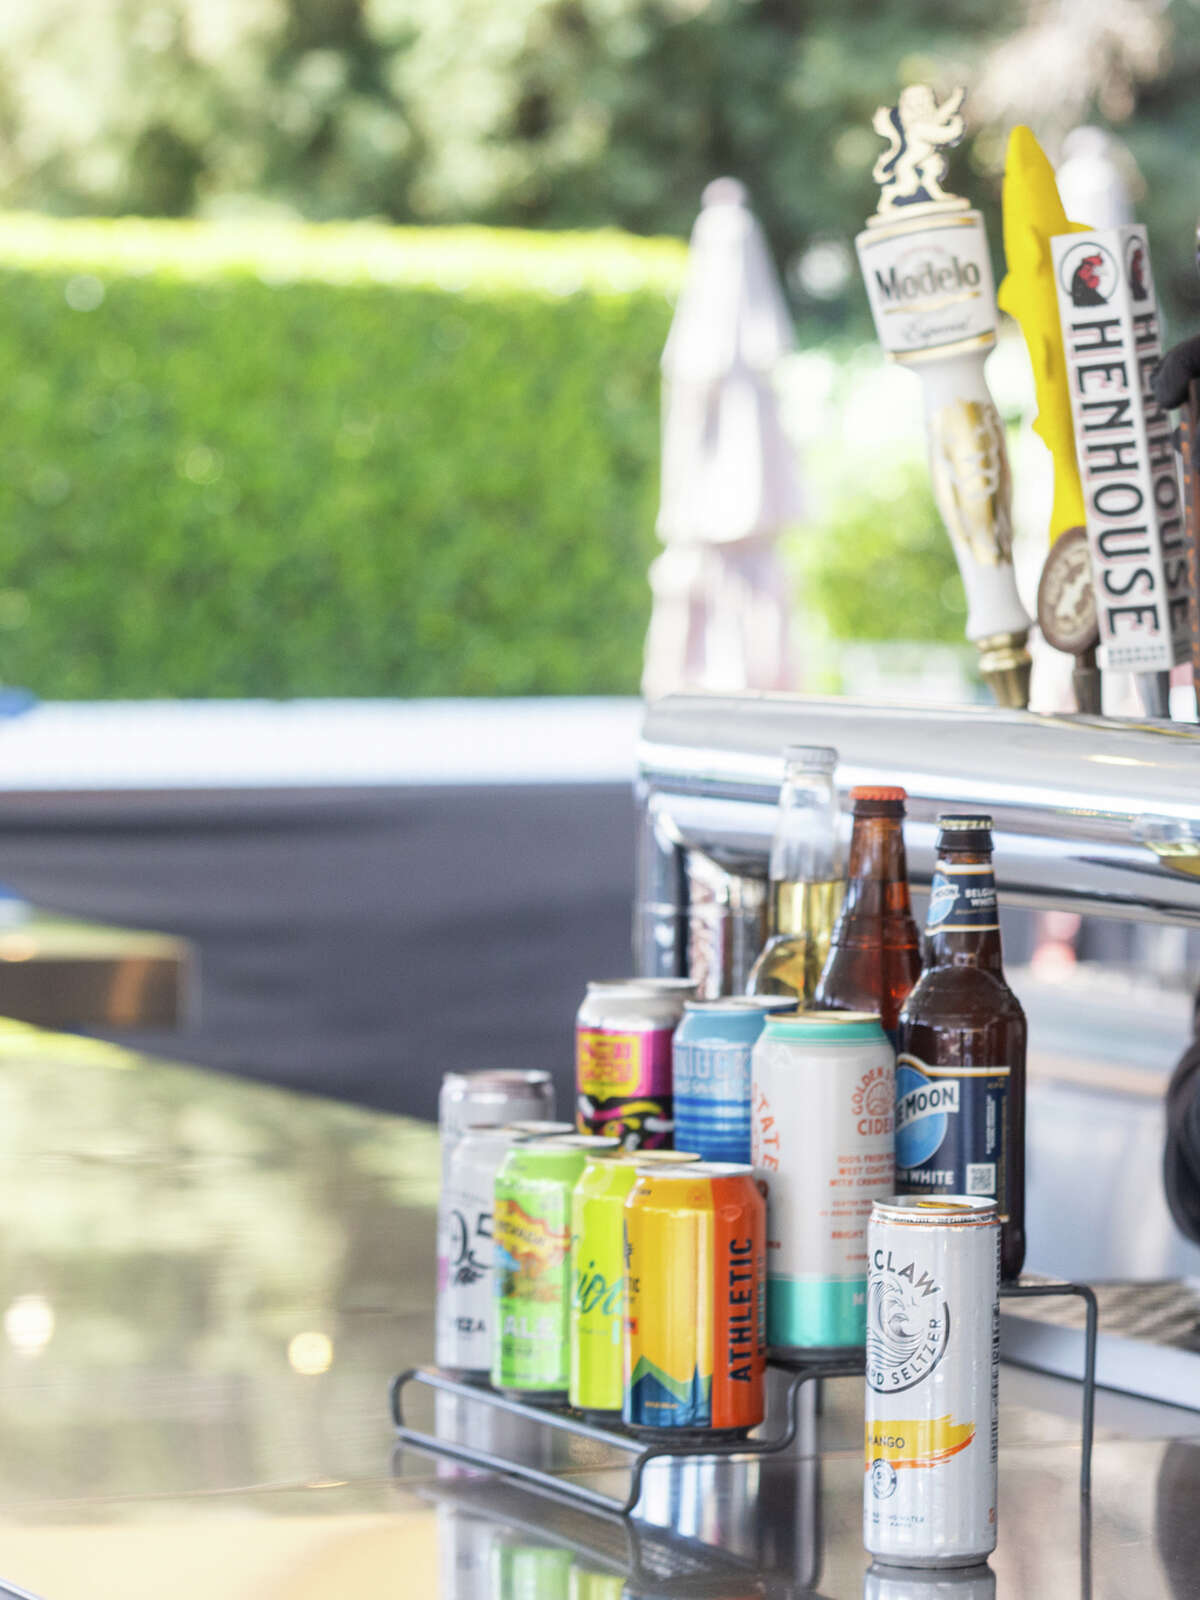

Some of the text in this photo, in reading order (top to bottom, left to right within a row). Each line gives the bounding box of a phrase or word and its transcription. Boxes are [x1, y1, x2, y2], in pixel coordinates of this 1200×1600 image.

[875, 256, 982, 302] Modelo
[1071, 318, 1160, 635] HENHOUSE
[905, 1086, 955, 1120] MOON
[756, 1092, 782, 1173] TATE
[911, 1169, 955, 1186] WHITE
[873, 1249, 942, 1298] CLAW
[728, 1238, 753, 1383] ATHLETIC
[890, 1318, 943, 1386] SELTZER
